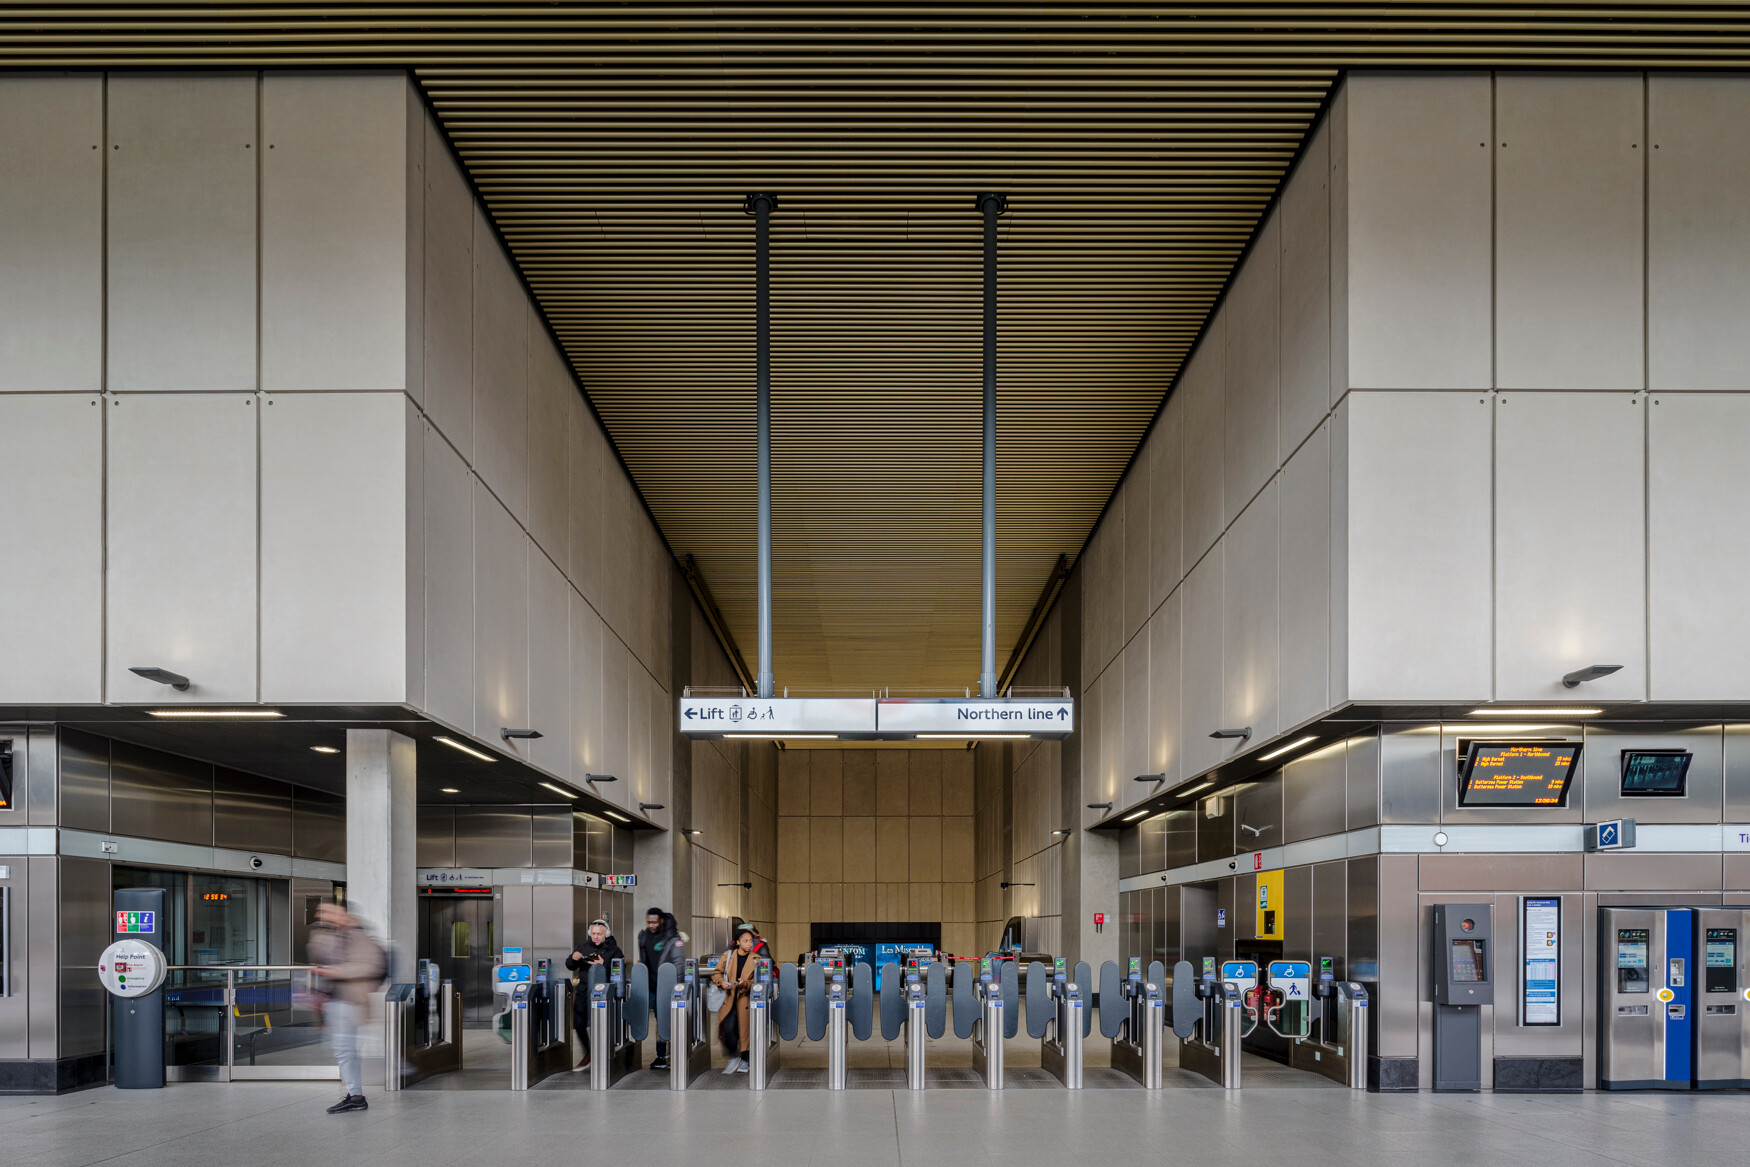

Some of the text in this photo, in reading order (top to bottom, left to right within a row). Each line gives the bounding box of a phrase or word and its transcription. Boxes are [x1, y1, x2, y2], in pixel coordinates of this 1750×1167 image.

[700, 708, 725, 720] Lift
[957, 708, 1054, 720] Northern line
[1739, 833, 1750, 843] Ti
[882, 946, 894, 954] Les
